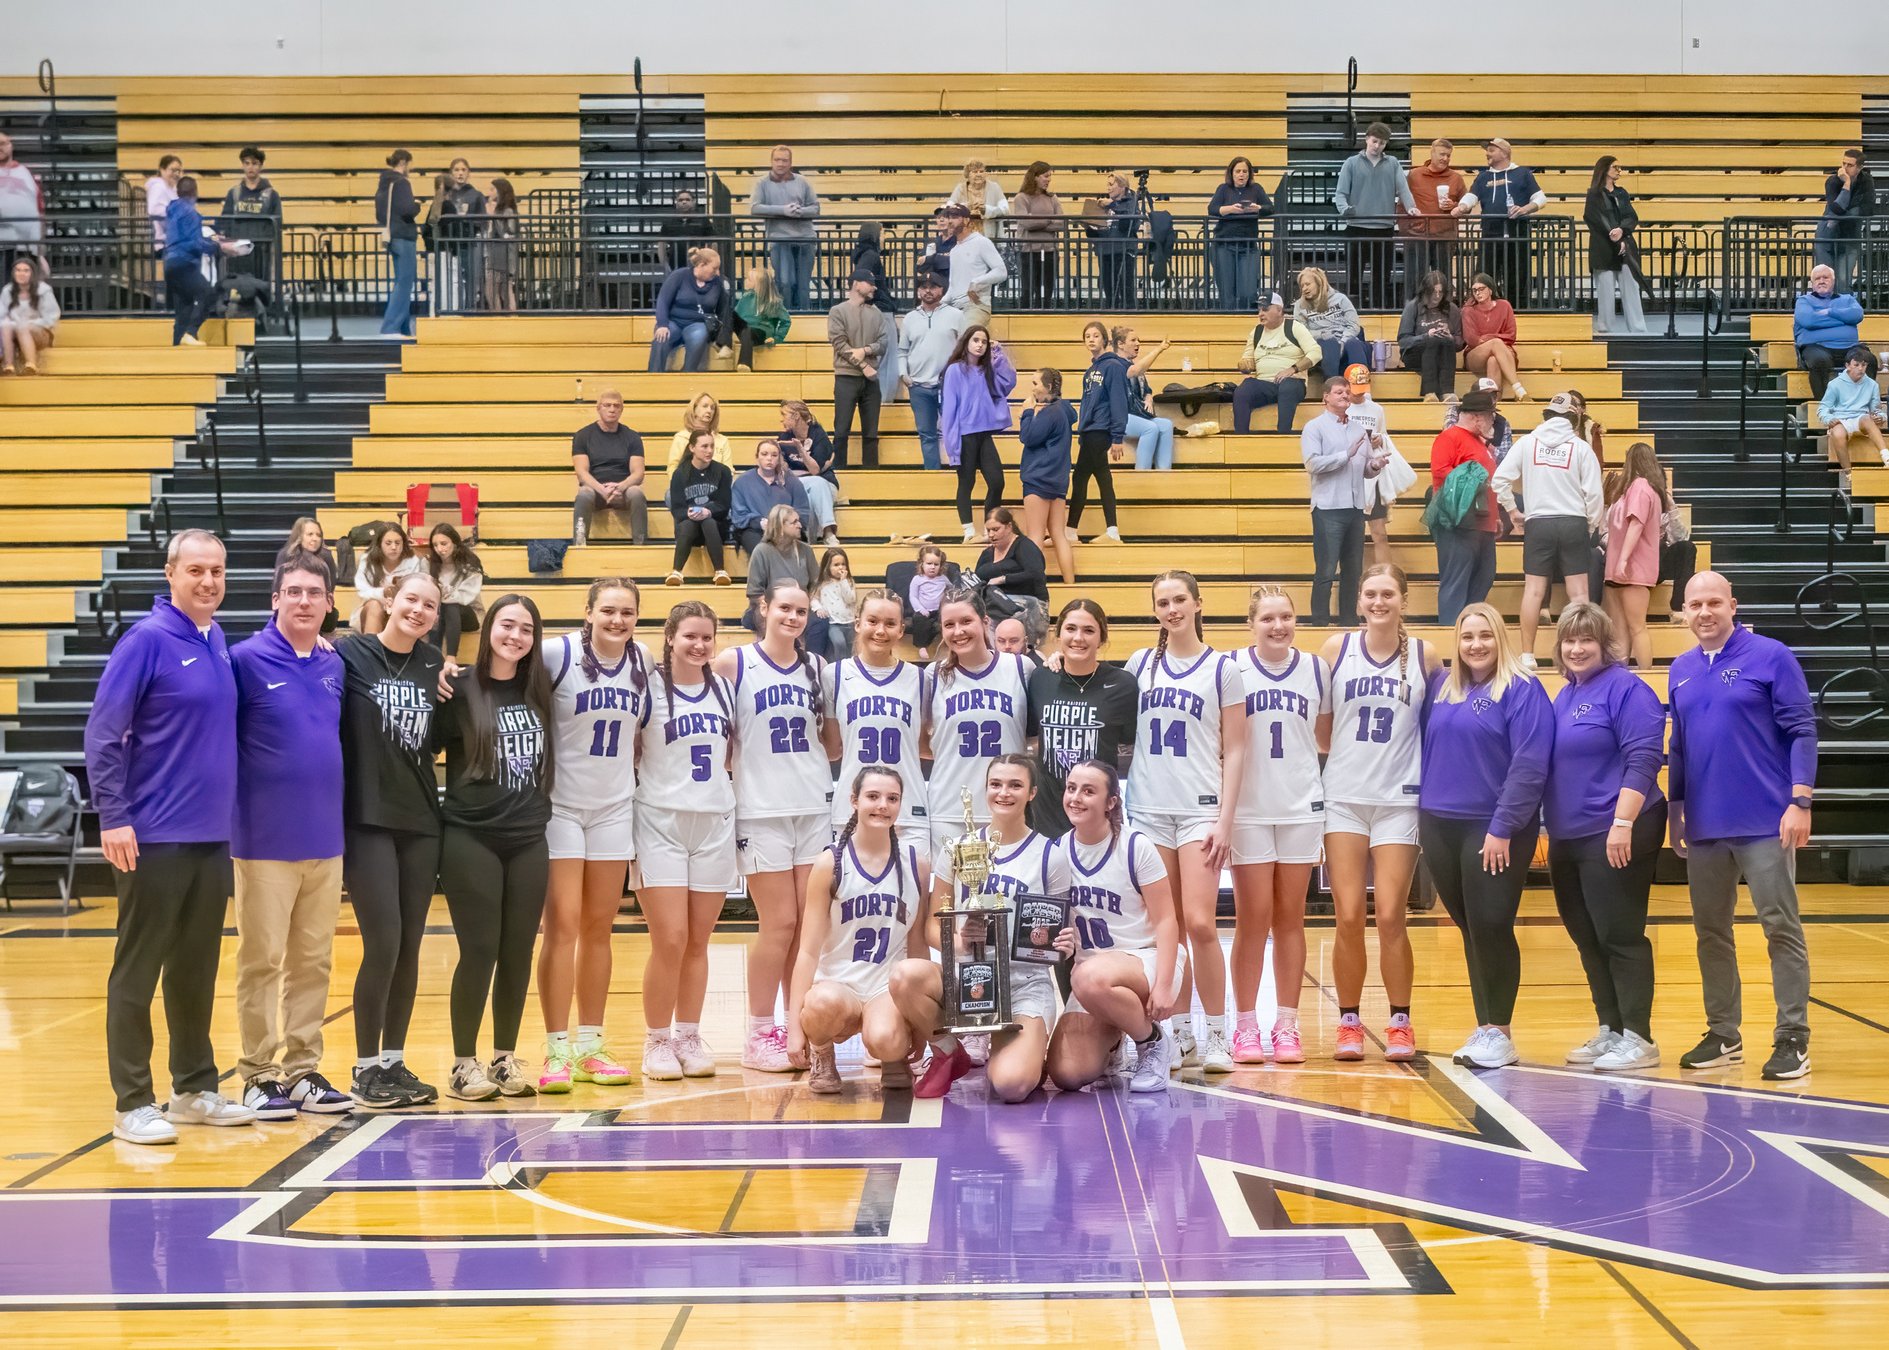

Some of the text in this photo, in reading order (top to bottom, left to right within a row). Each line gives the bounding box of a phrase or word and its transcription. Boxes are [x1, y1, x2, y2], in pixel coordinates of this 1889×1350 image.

[1539, 447, 1567, 457] RODES
[574, 687, 640, 718] NORTH
[846, 695, 912, 728] NORTH
[945, 688, 1014, 721] NORTH
[1043, 704, 1098, 726] PURPLE
[1140, 686, 1205, 722] NORTH
[1246, 688, 1308, 721] NORTH
[496, 709, 544, 733] URPLE
[589, 719, 622, 757] 11
[664, 712, 729, 746] NORTH
[769, 716, 810, 754] 22
[1149, 718, 1187, 758] 14
[1355, 706, 1395, 744] 13
[858, 726, 902, 764] 30
[957, 720, 1002, 758] 32
[1043, 727, 1097, 751] REIGN
[1270, 721, 1284, 759] 1
[690, 744, 712, 782] 5
[841, 892, 907, 926] NORTH
[1070, 885, 1123, 917] ORTH
[852, 927, 891, 965] 21
[1074, 915, 1115, 950] 10
